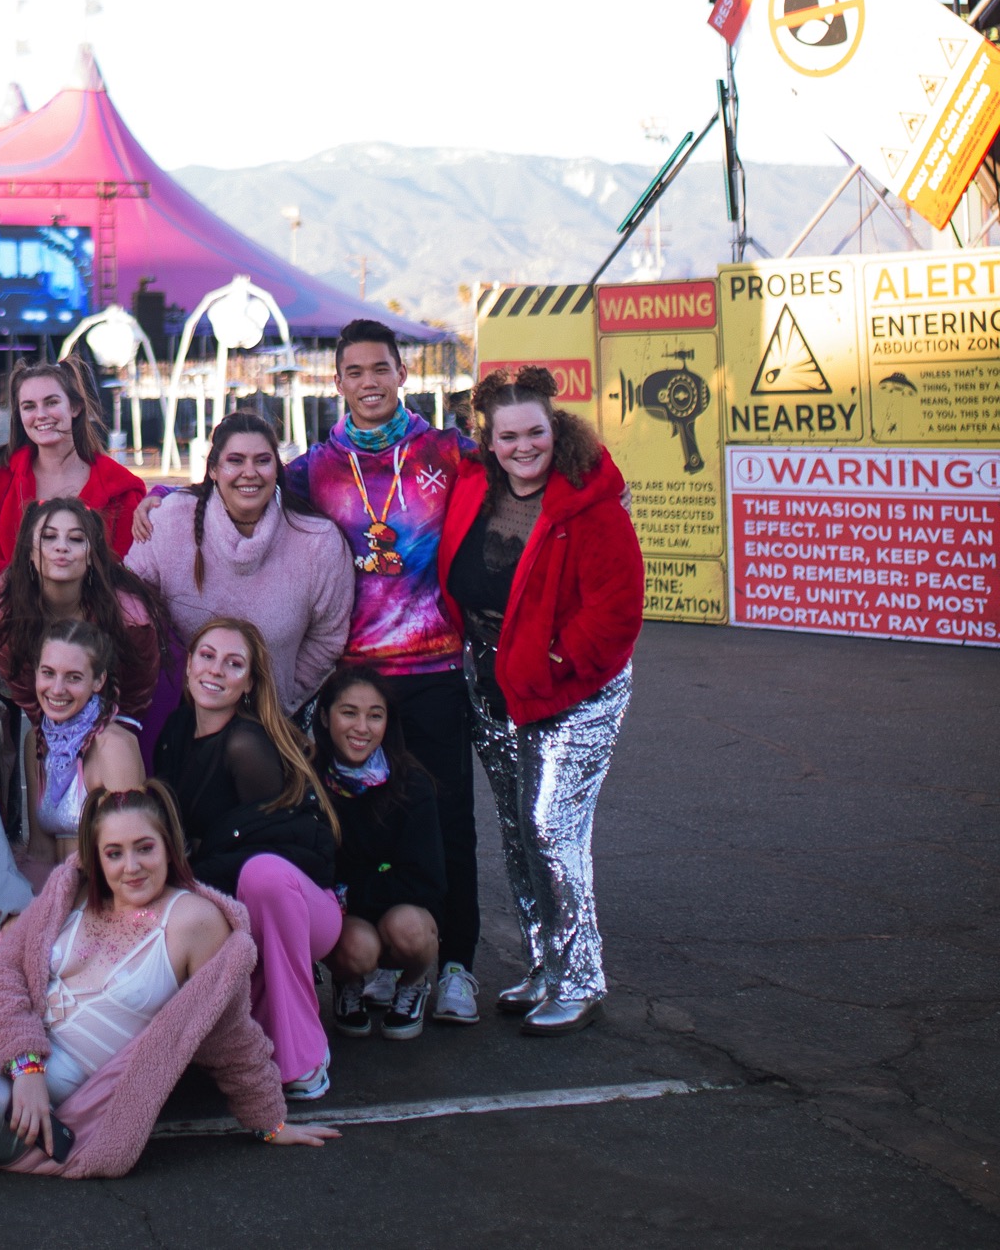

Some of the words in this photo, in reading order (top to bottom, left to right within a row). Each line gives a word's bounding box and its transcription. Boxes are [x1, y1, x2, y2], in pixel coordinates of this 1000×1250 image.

[730, 270, 843, 300] PROBES
[873, 261, 1000, 300] ALERT
[601, 293, 713, 321] WARNING
[873, 339, 960, 355] ABDUCTION
[968, 337, 1000, 351] ZON
[920, 370, 950, 379] UNLESS
[954, 367, 983, 378] THAT'S
[988, 368, 1000, 376] YO
[923, 384, 950, 393] THING,
[954, 382, 976, 391] THEN
[980, 382, 991, 390] BY
[920, 397, 952, 407] MEANS,
[955, 396, 978, 405] MORE
[982, 395, 1000, 405] POW
[731, 404, 857, 432] NEARBY
[960, 410, 979, 418] THIS
[982, 409, 990, 417] IS
[928, 424, 934, 432] A
[938, 424, 957, 432] SIGN
[960, 423, 987, 432] AFTER
[991, 422, 1000, 431] AL
[767, 458, 974, 488] WARNING
[646, 481, 662, 490] ARE
[667, 481, 686, 490] NOT
[689, 482, 714, 491] TOYS.
[632, 495, 666, 505] CENSED
[669, 496, 716, 506] CARRIERS
[637, 510, 647, 518] BE
[651, 510, 714, 520] PROSECUTED
[743, 499, 780, 515] THE
[785, 500, 881, 519] INVASION
[888, 504, 907, 520] IS
[913, 505, 934, 521] IN
[941, 506, 994, 523] FULL
[641, 523, 680, 533] FULLEST
[744, 521, 820, 538] EFFECT.
[825, 524, 843, 539] IF
[849, 525, 892, 541] YOU
[899, 527, 955, 544] HAVE
[961, 529, 993, 546] AN
[647, 538, 665, 546] THE
[668, 539, 691, 548] LAW.
[744, 542, 871, 565] ENCOUNTER,
[876, 547, 930, 566] KEEP
[935, 551, 997, 569] CALM
[745, 563, 787, 579] AND
[792, 564, 909, 587] REMEMBER:
[915, 572, 992, 595] PEACE,
[644, 595, 720, 613] ORIZATION
[745, 584, 801, 605] LOVE,
[806, 587, 869, 608] UNITY,
[875, 591, 921, 610] AND
[927, 595, 988, 615] MOST
[746, 605, 882, 629] IMPORTANTLY
[888, 615, 929, 633] RAY
[936, 618, 1000, 637] GUNS.
